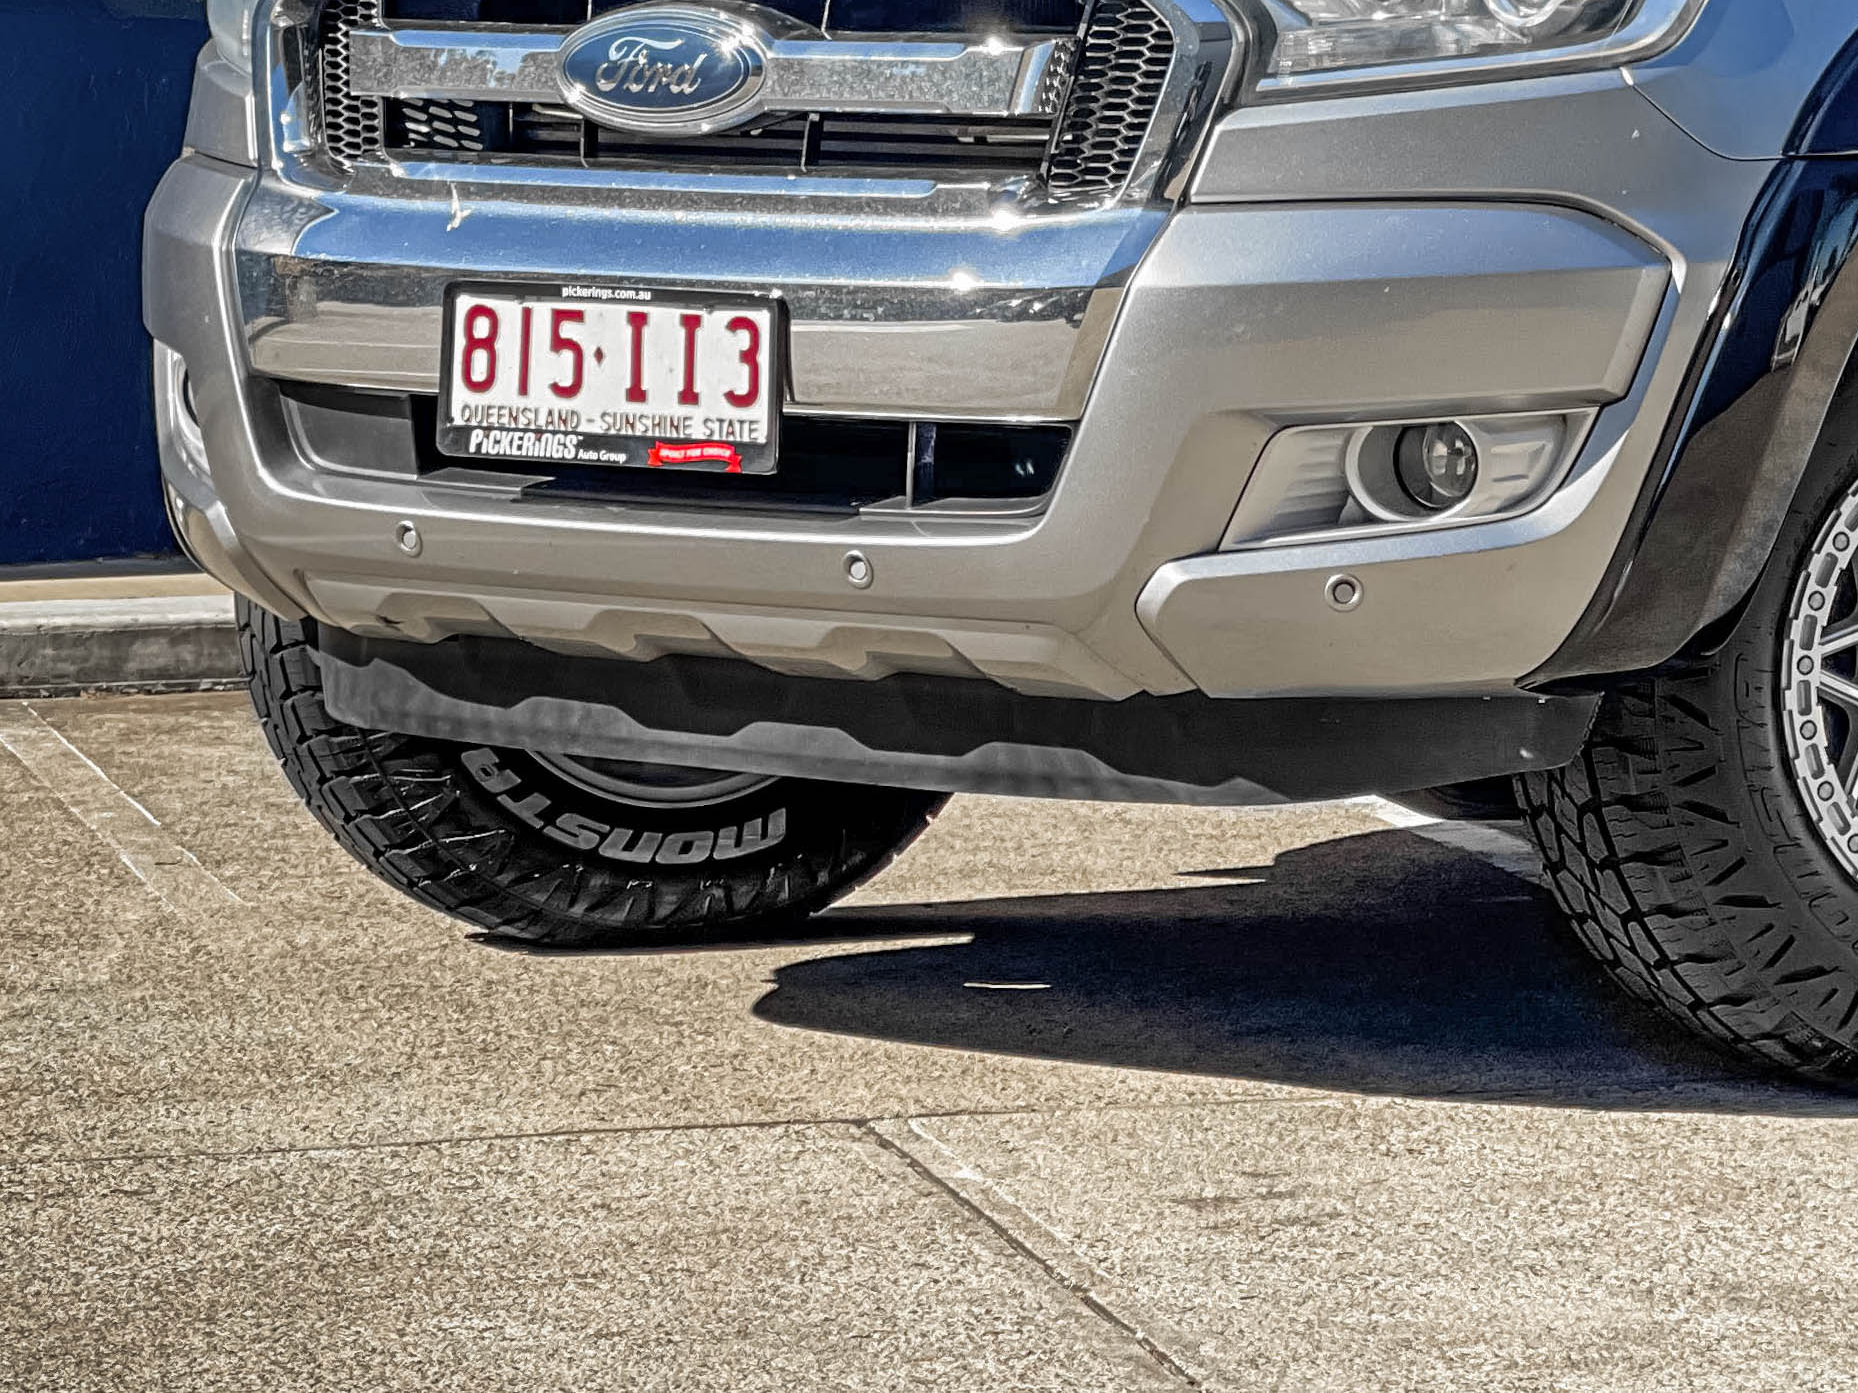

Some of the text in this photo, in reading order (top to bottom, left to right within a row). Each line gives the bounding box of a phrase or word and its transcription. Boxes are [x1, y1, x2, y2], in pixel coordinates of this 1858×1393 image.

[595, 36, 708, 95] Ford
[562, 286, 652, 300] pickerings.com.au
[460, 404, 581, 432] QUEENSLAND
[599, 411, 693, 436] SUNSHINE
[703, 418, 761, 441] STATE
[577, 449, 598, 460] Auto
[599, 450, 627, 464] Group
[461, 747, 787, 864] MONSTA
